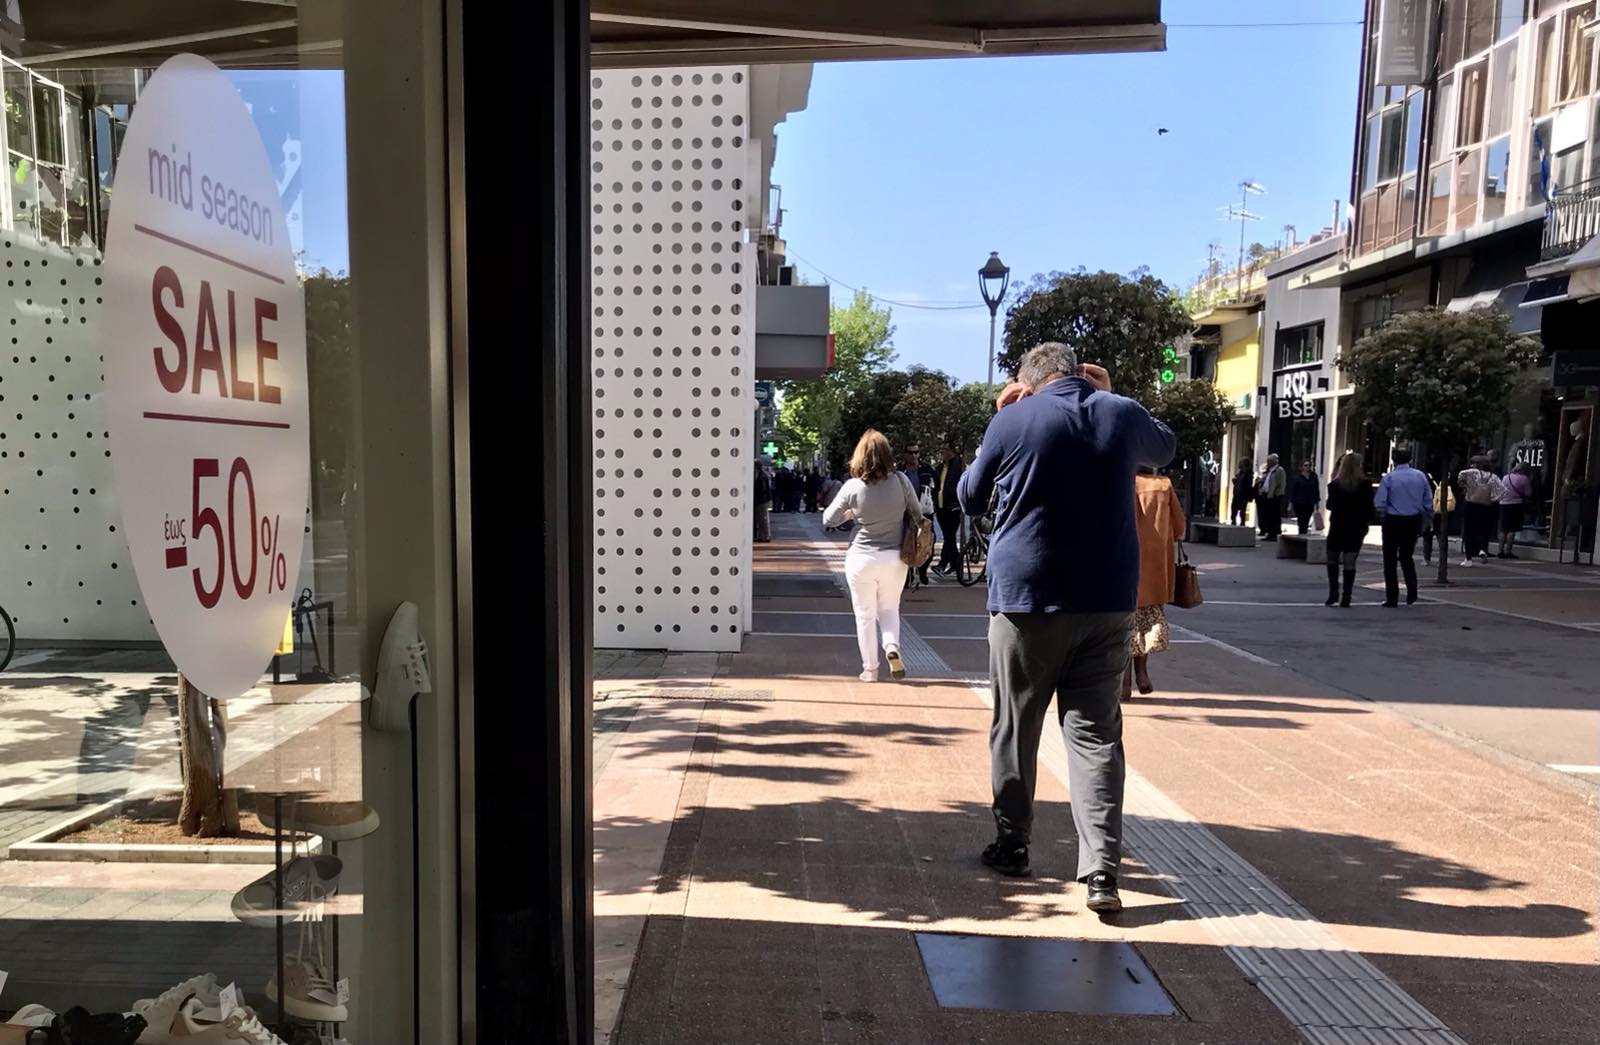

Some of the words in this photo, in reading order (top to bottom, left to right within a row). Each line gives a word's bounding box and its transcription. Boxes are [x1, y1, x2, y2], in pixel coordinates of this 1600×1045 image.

[148, 143, 193, 211] mid
[201, 175, 274, 246] season
[152, 265, 281, 405] SALE
[1279, 399, 1316, 418] BSB
[1516, 449, 1544, 467] SALE
[164, 513, 186, 545] έως
[165, 456, 287, 609] -50%
